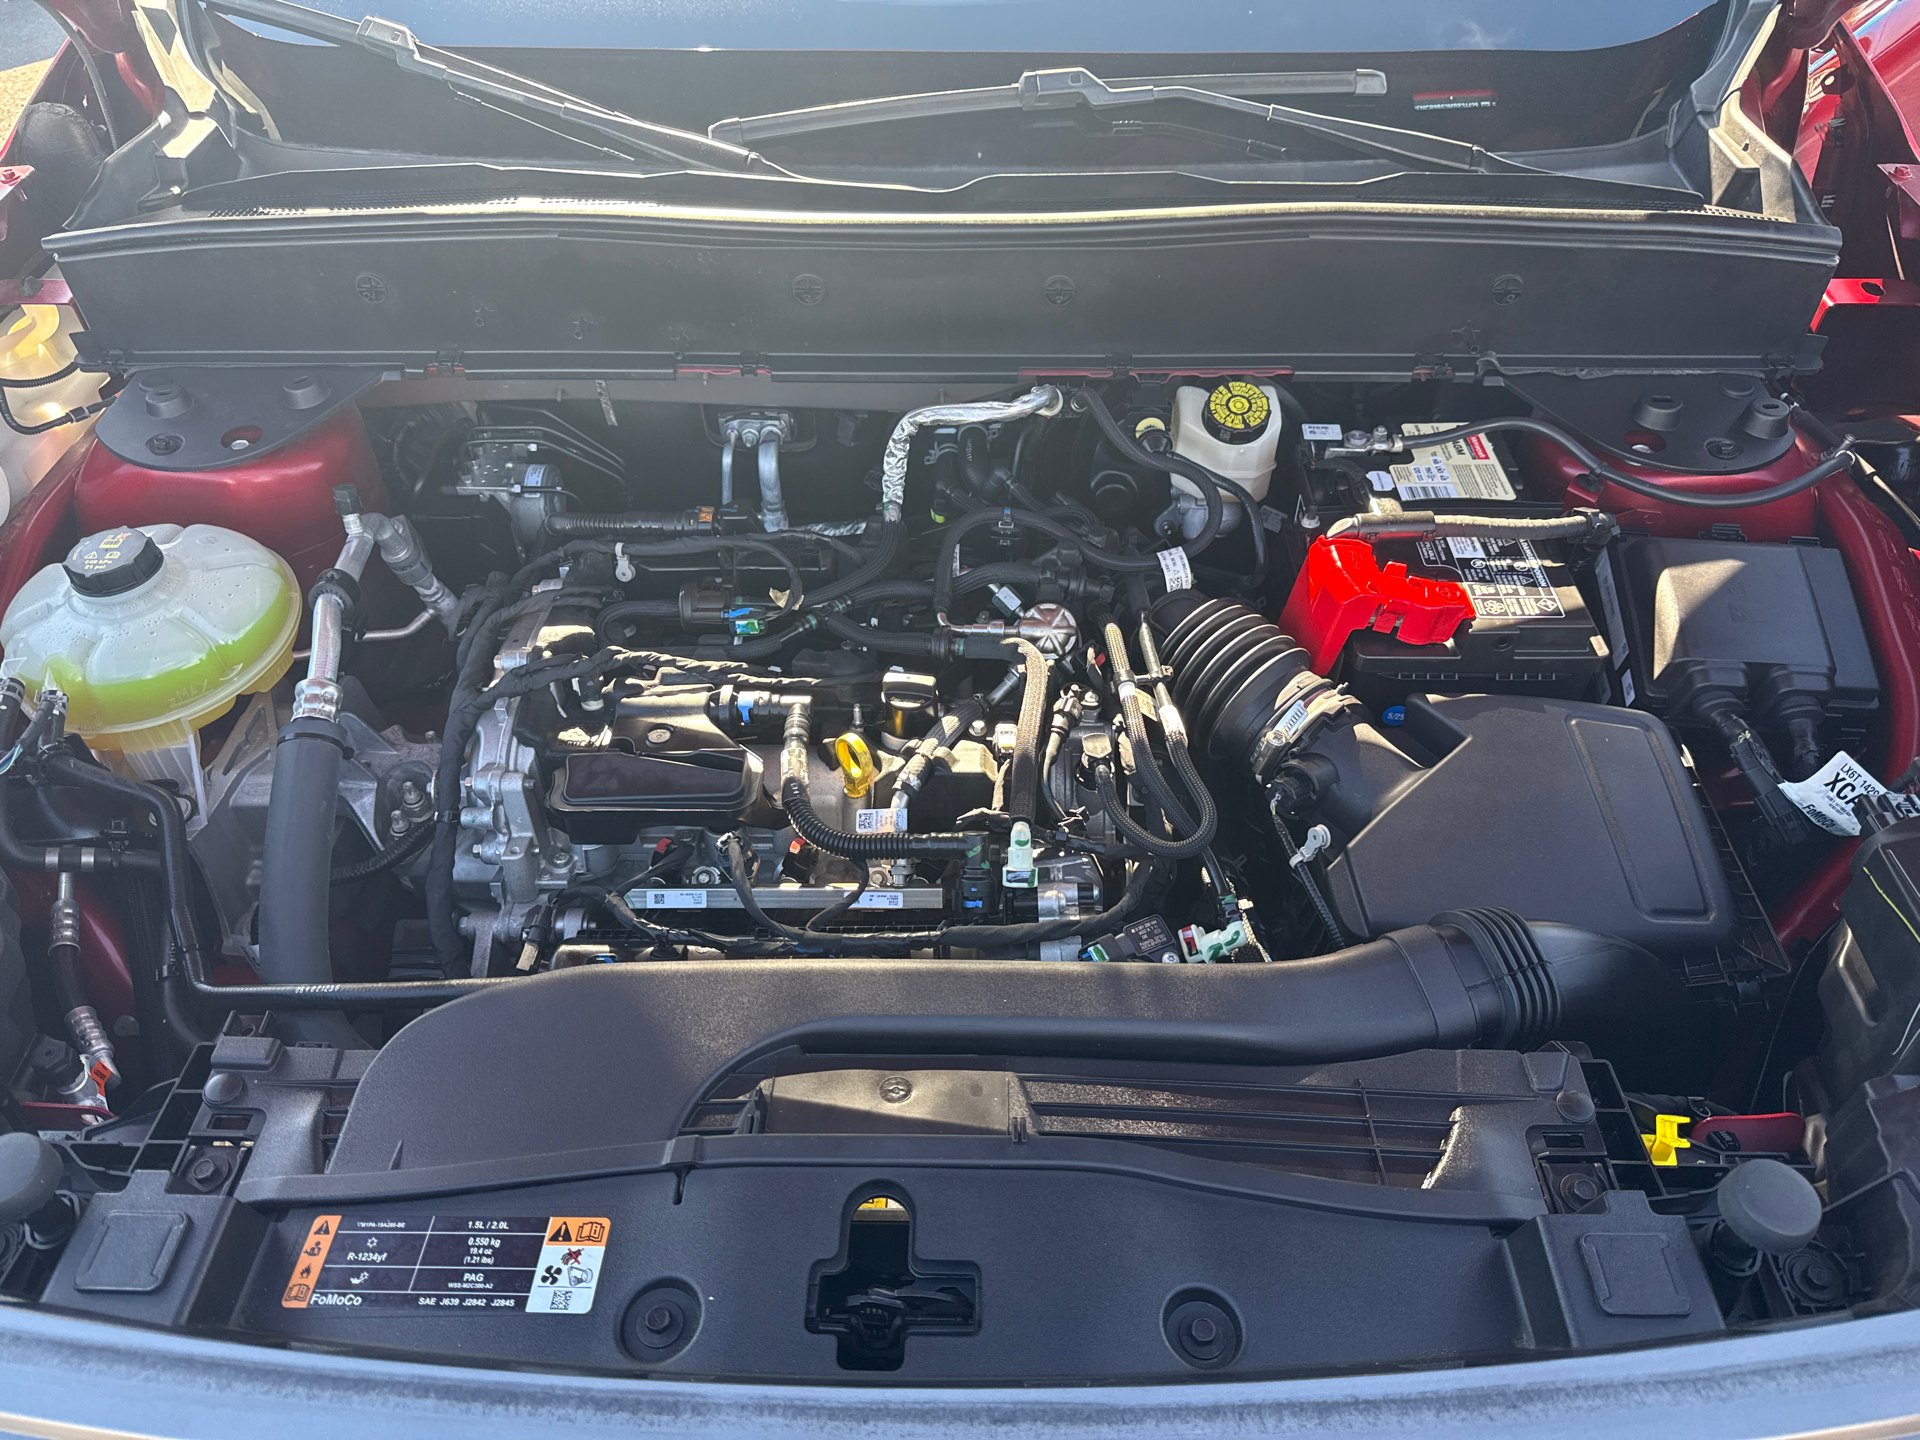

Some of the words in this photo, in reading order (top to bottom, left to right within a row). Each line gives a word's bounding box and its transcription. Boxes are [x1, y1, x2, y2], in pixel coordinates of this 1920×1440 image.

[1471, 436, 1486, 458] Motorcraft
[1387, 712, 1405, 721] 5/25
[1840, 763, 1862, 782] LX6T
[1802, 803, 1836, 829] FoMoCo
[468, 1220, 485, 1230] 1.5L
[490, 1220, 509, 1230] 2.0L
[468, 1236, 490, 1246] 0.550
[490, 1237, 501, 1248] kg
[469, 1247, 484, 1255] 19.4
[346, 1252, 388, 1263] R-1234yf
[463, 1255, 480, 1265] (1.21
[481, 1255, 495, 1265] lbs)
[463, 1272, 484, 1282] PAG
[310, 1293, 362, 1306] FoMoCo
[418, 1297, 436, 1306] SAE
[439, 1297, 459, 1307] J639
[462, 1298, 486, 1307] J2842
[490, 1298, 515, 1307] J2845
